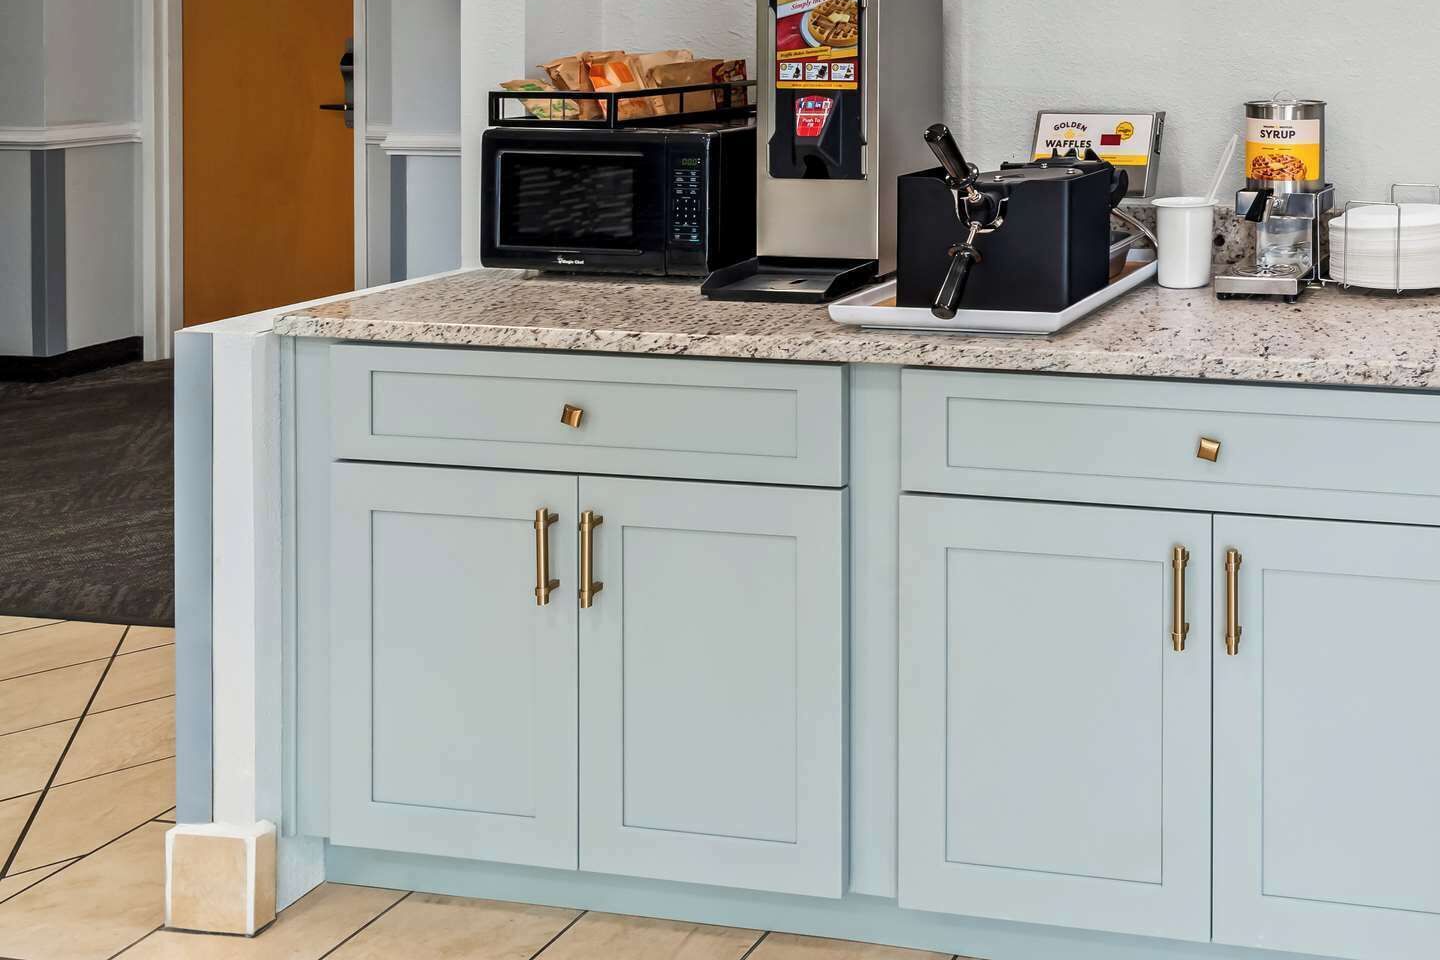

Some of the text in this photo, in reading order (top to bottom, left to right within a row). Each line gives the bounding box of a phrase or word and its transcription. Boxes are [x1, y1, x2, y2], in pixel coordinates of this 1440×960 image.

[790, 0, 811, 10] Simply
[1053, 121, 1088, 132] GOLDEN
[1260, 129, 1296, 139] SYRUP
[1045, 139, 1092, 149] WAFFLES
